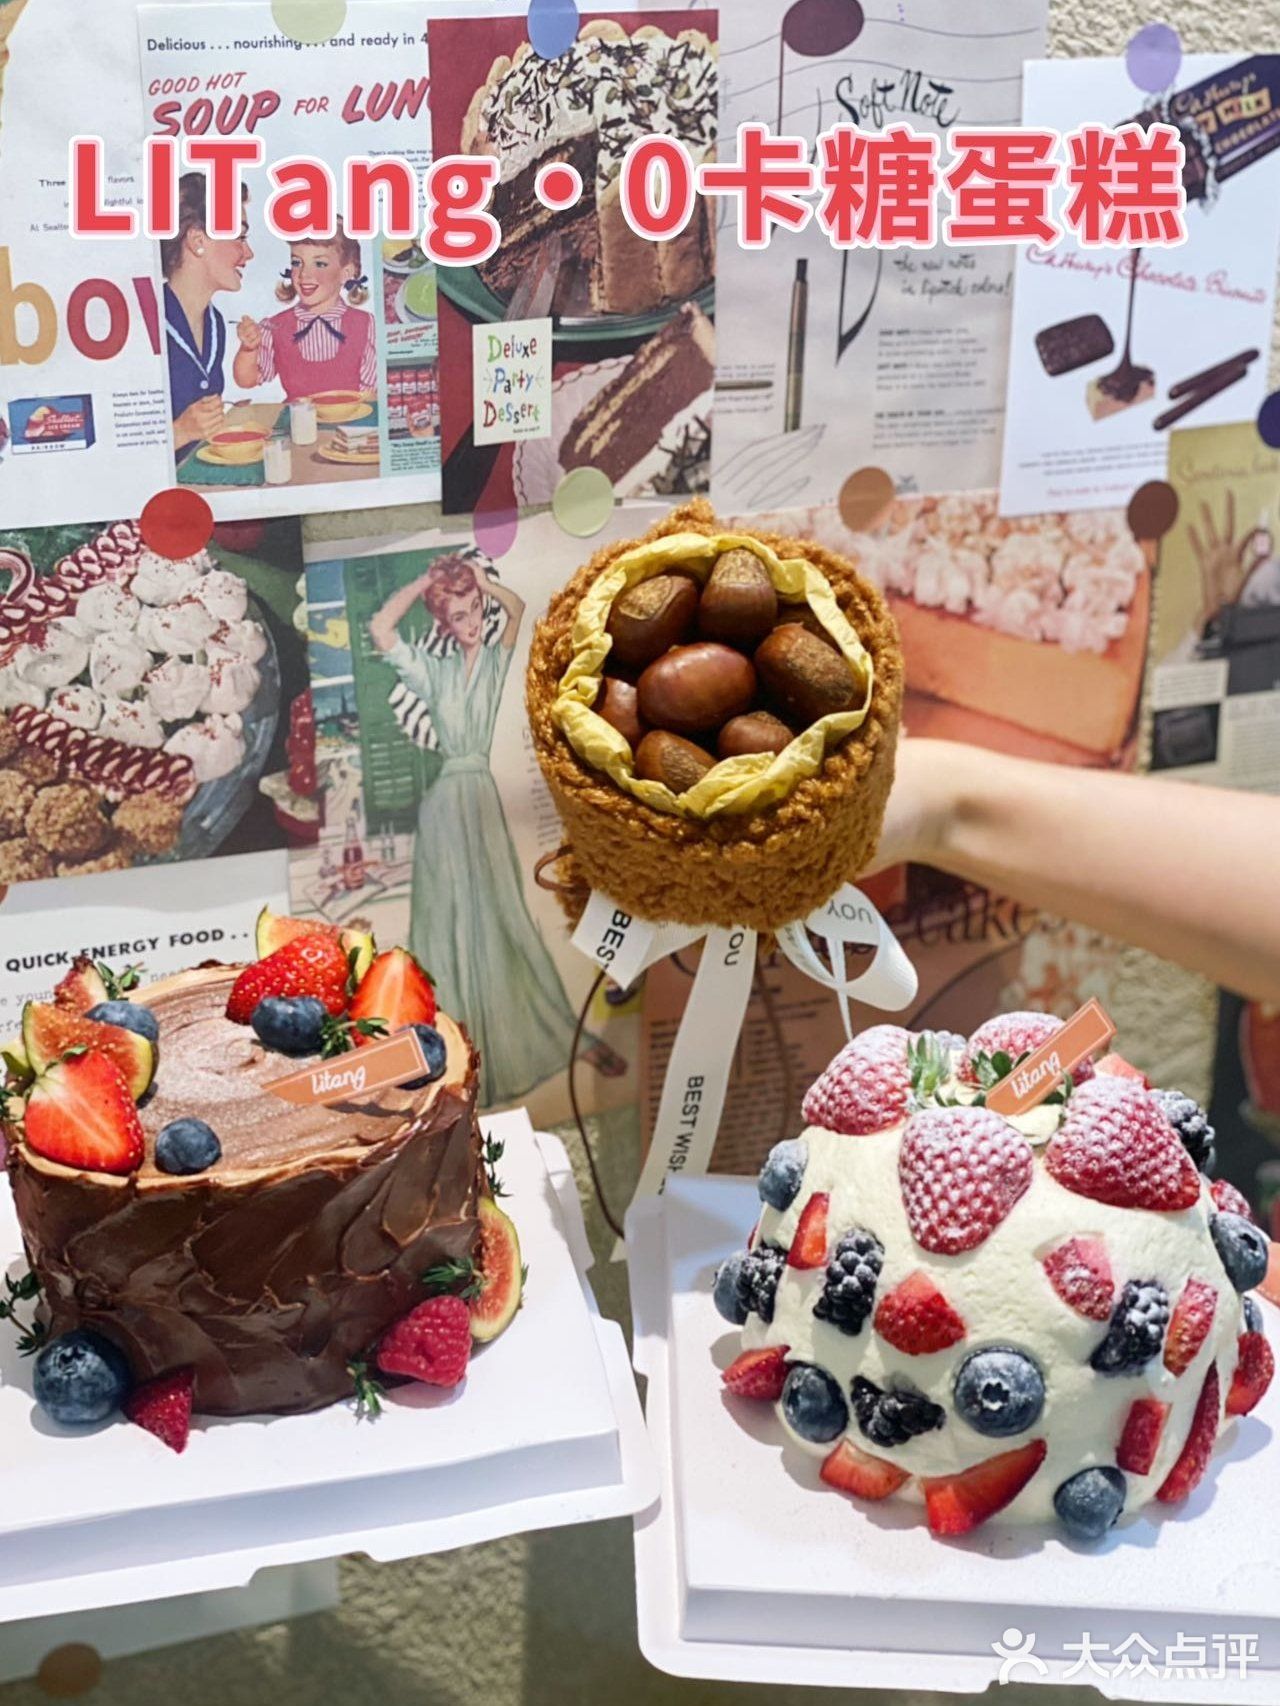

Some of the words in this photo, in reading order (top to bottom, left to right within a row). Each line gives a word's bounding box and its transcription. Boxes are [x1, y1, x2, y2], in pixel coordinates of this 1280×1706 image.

[147, 37, 206, 51] Delicious
[233, 35, 302, 51] nourishing
[330, 33, 355, 47] and
[361, 32, 399, 49] ready
[403, 33, 415, 45] in
[148, 76, 200, 96] GOOD
[205, 71, 248, 91] HOT
[836, 75, 895, 129] Soft
[901, 69, 961, 128] Note
[153, 90, 281, 136] SOUP
[293, 96, 329, 116] FOR
[341, 76, 430, 124] LUN
[39, 179, 67, 188] Three
[487, 335, 537, 363] Deluxe
[493, 366, 534, 393] Party
[5, 951, 69, 973] QUICK
[80, 937, 160, 962] ENERGY
[169, 928, 225, 948] FOOD
[596, 909, 632, 970] BES
[724, 927, 745, 966] OU
[679, 1074, 705, 1130] BEST
